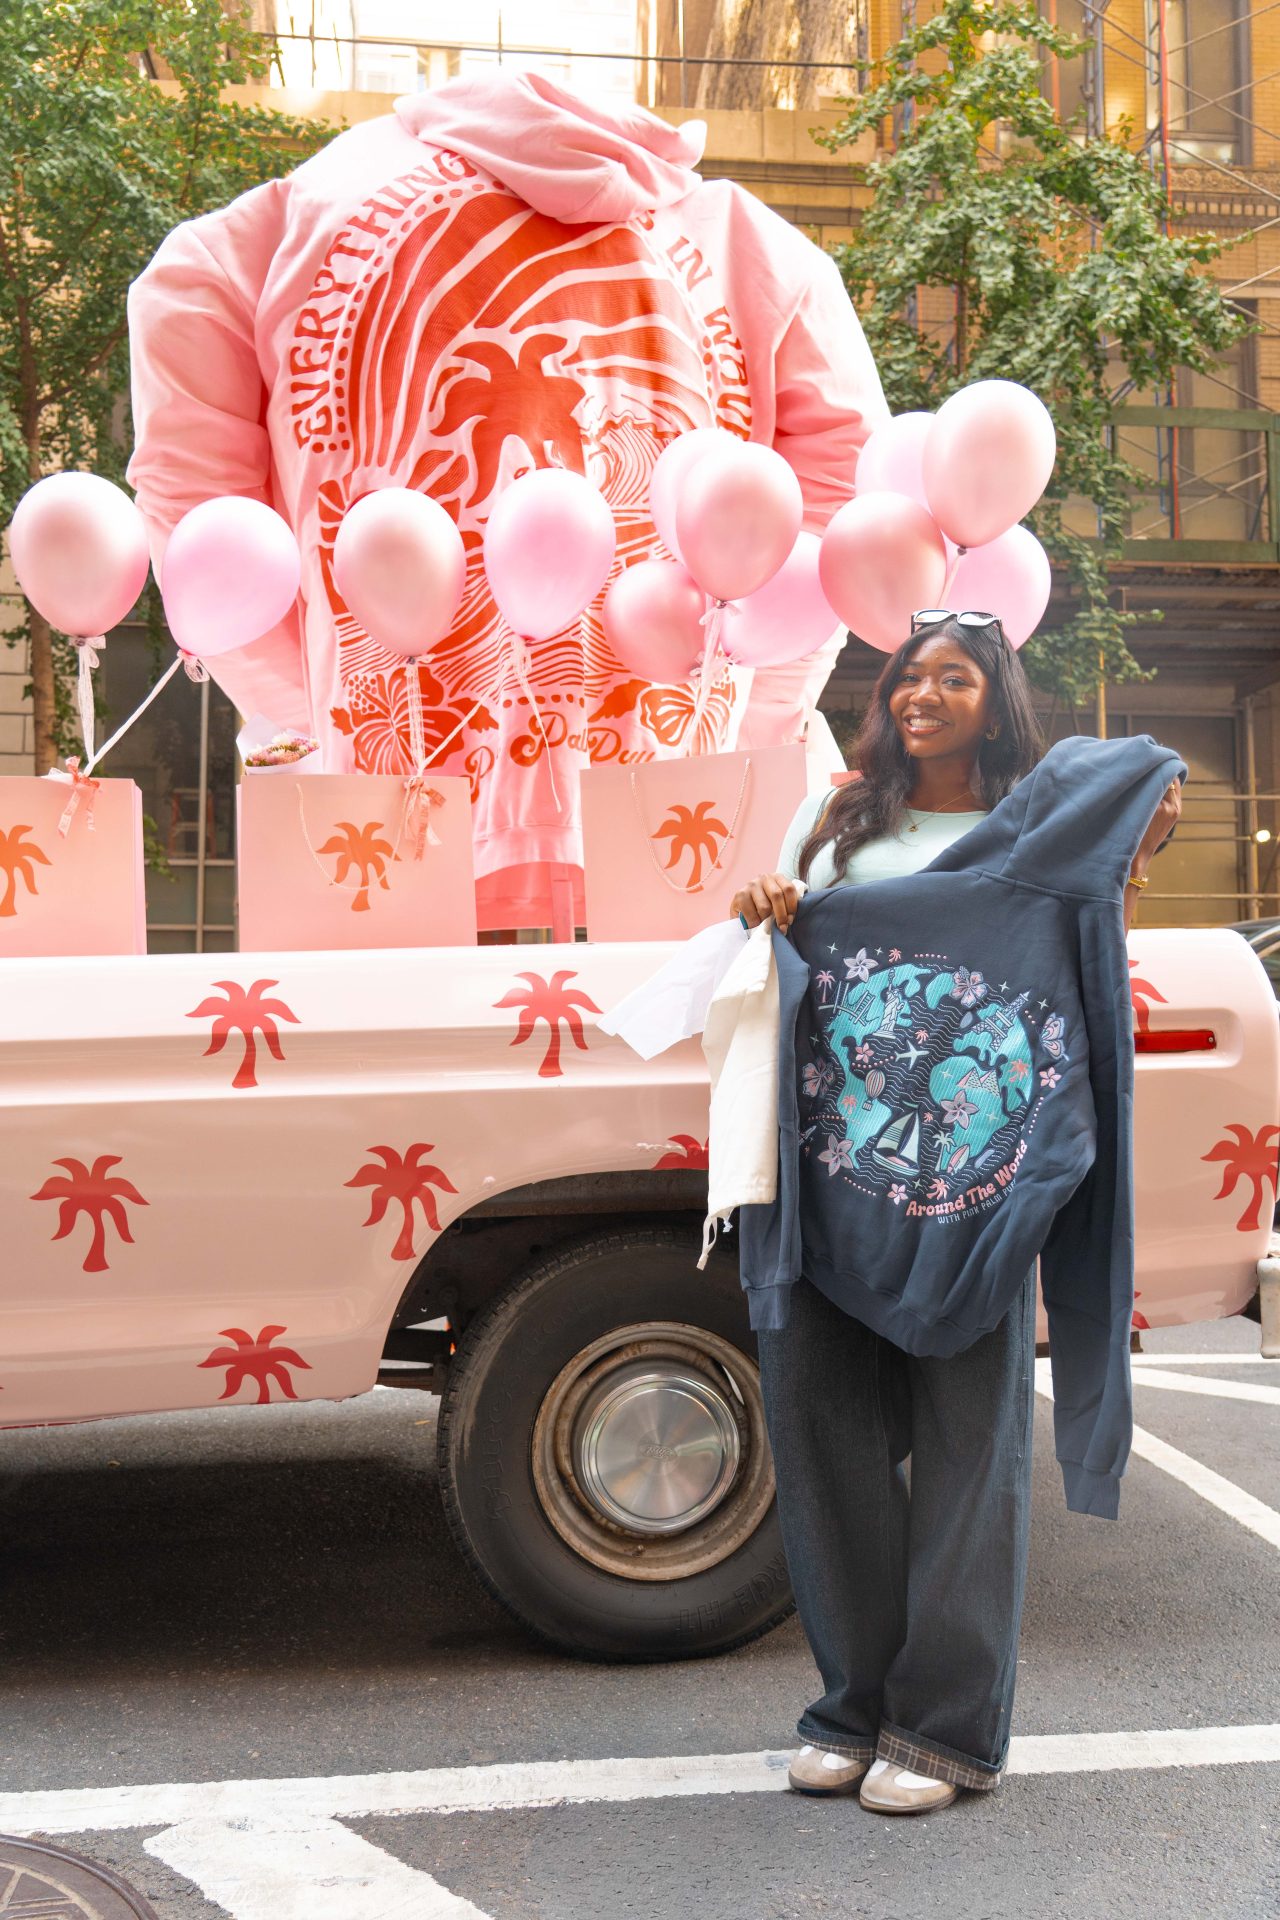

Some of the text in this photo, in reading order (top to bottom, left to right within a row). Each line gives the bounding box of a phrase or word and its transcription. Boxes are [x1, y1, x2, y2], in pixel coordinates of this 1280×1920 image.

[666, 235, 713, 292] IN
[289, 148, 477, 450] EVERYTHING
[906, 1139, 1028, 1217] Around The World
[937, 1213, 960, 1224] WITH
[981, 1193, 1003, 1210] PALM
